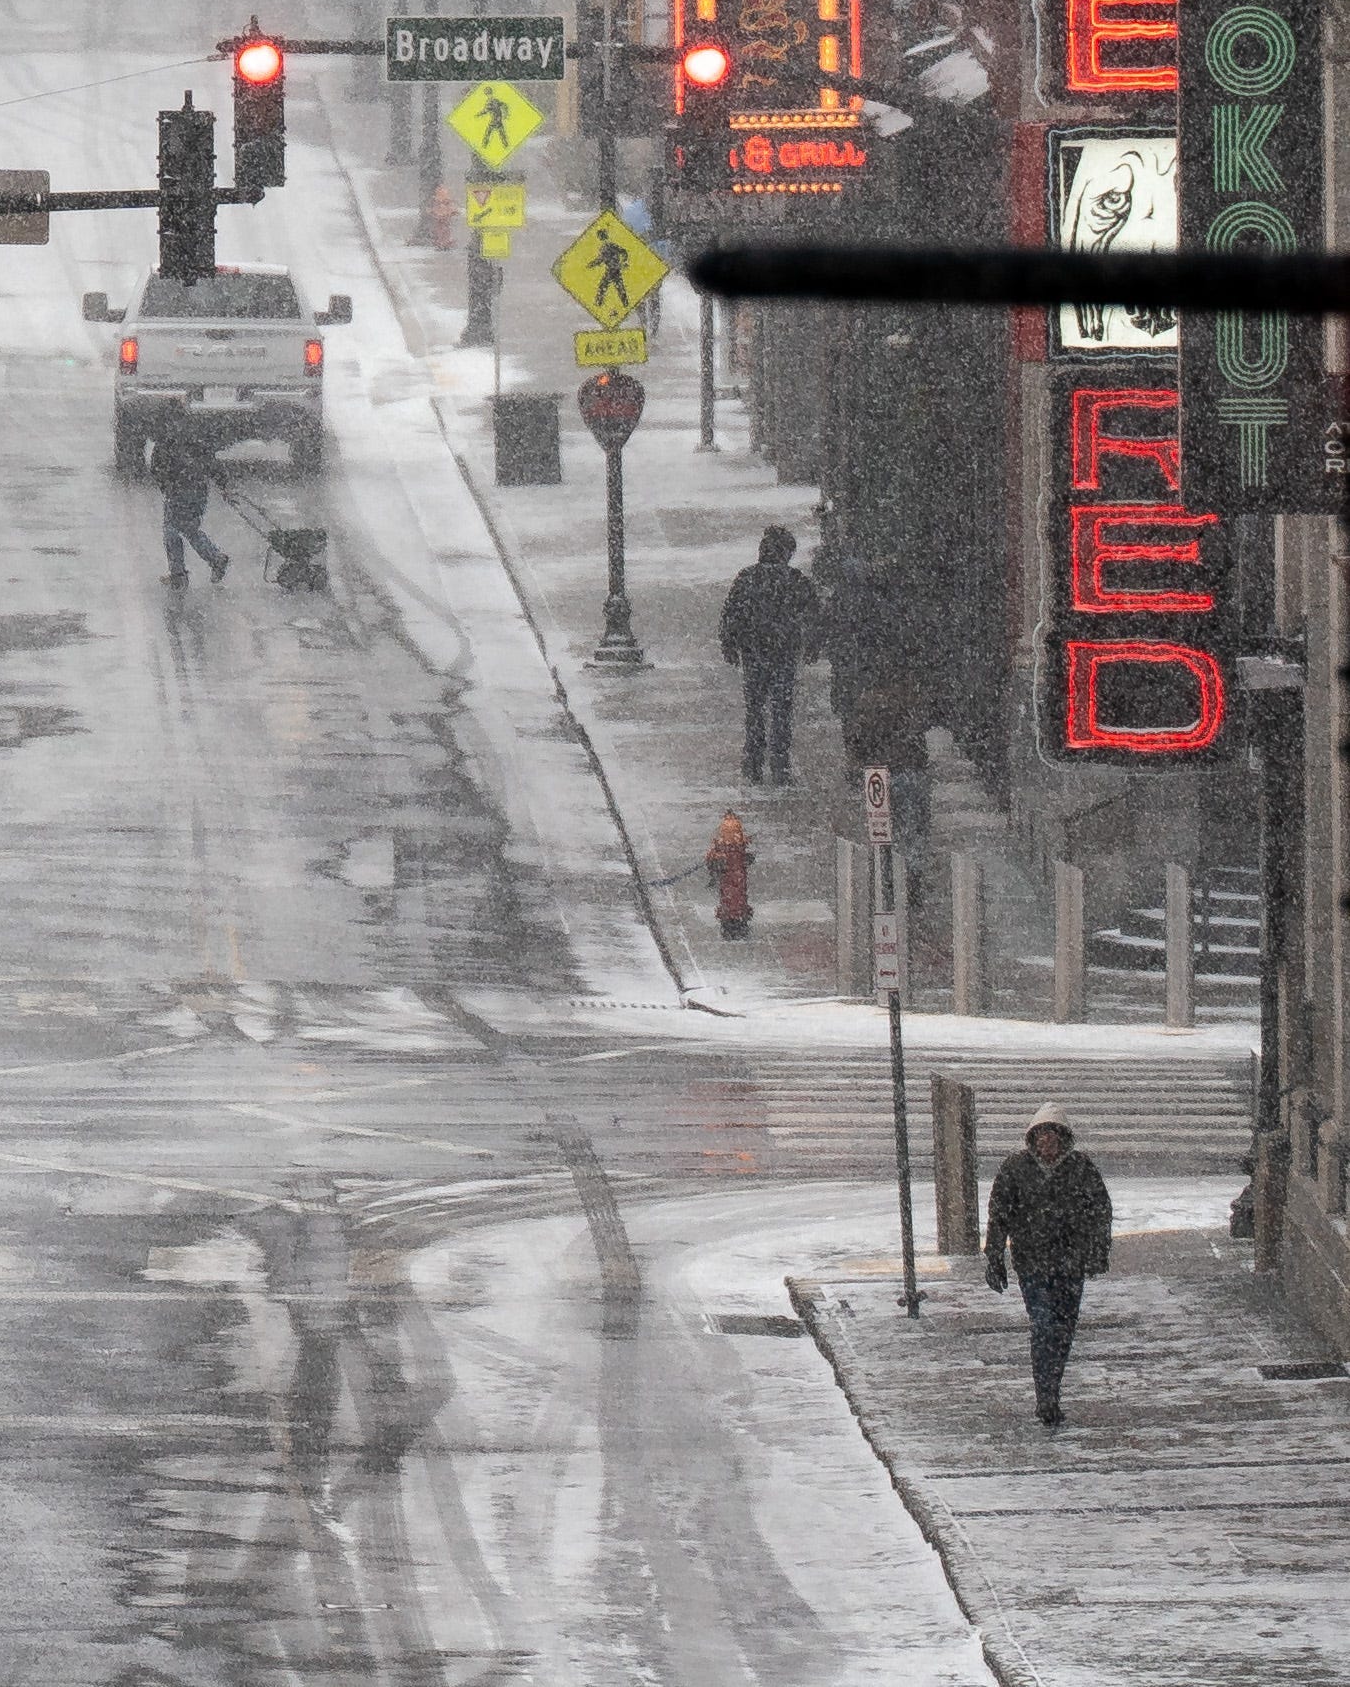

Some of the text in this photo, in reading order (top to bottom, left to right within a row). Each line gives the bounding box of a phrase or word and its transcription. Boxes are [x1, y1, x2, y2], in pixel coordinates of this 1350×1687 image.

[395, 30, 556, 69] Broadway
[779, 141, 866, 167] GRILL
[583, 337, 638, 358] AHEAD
